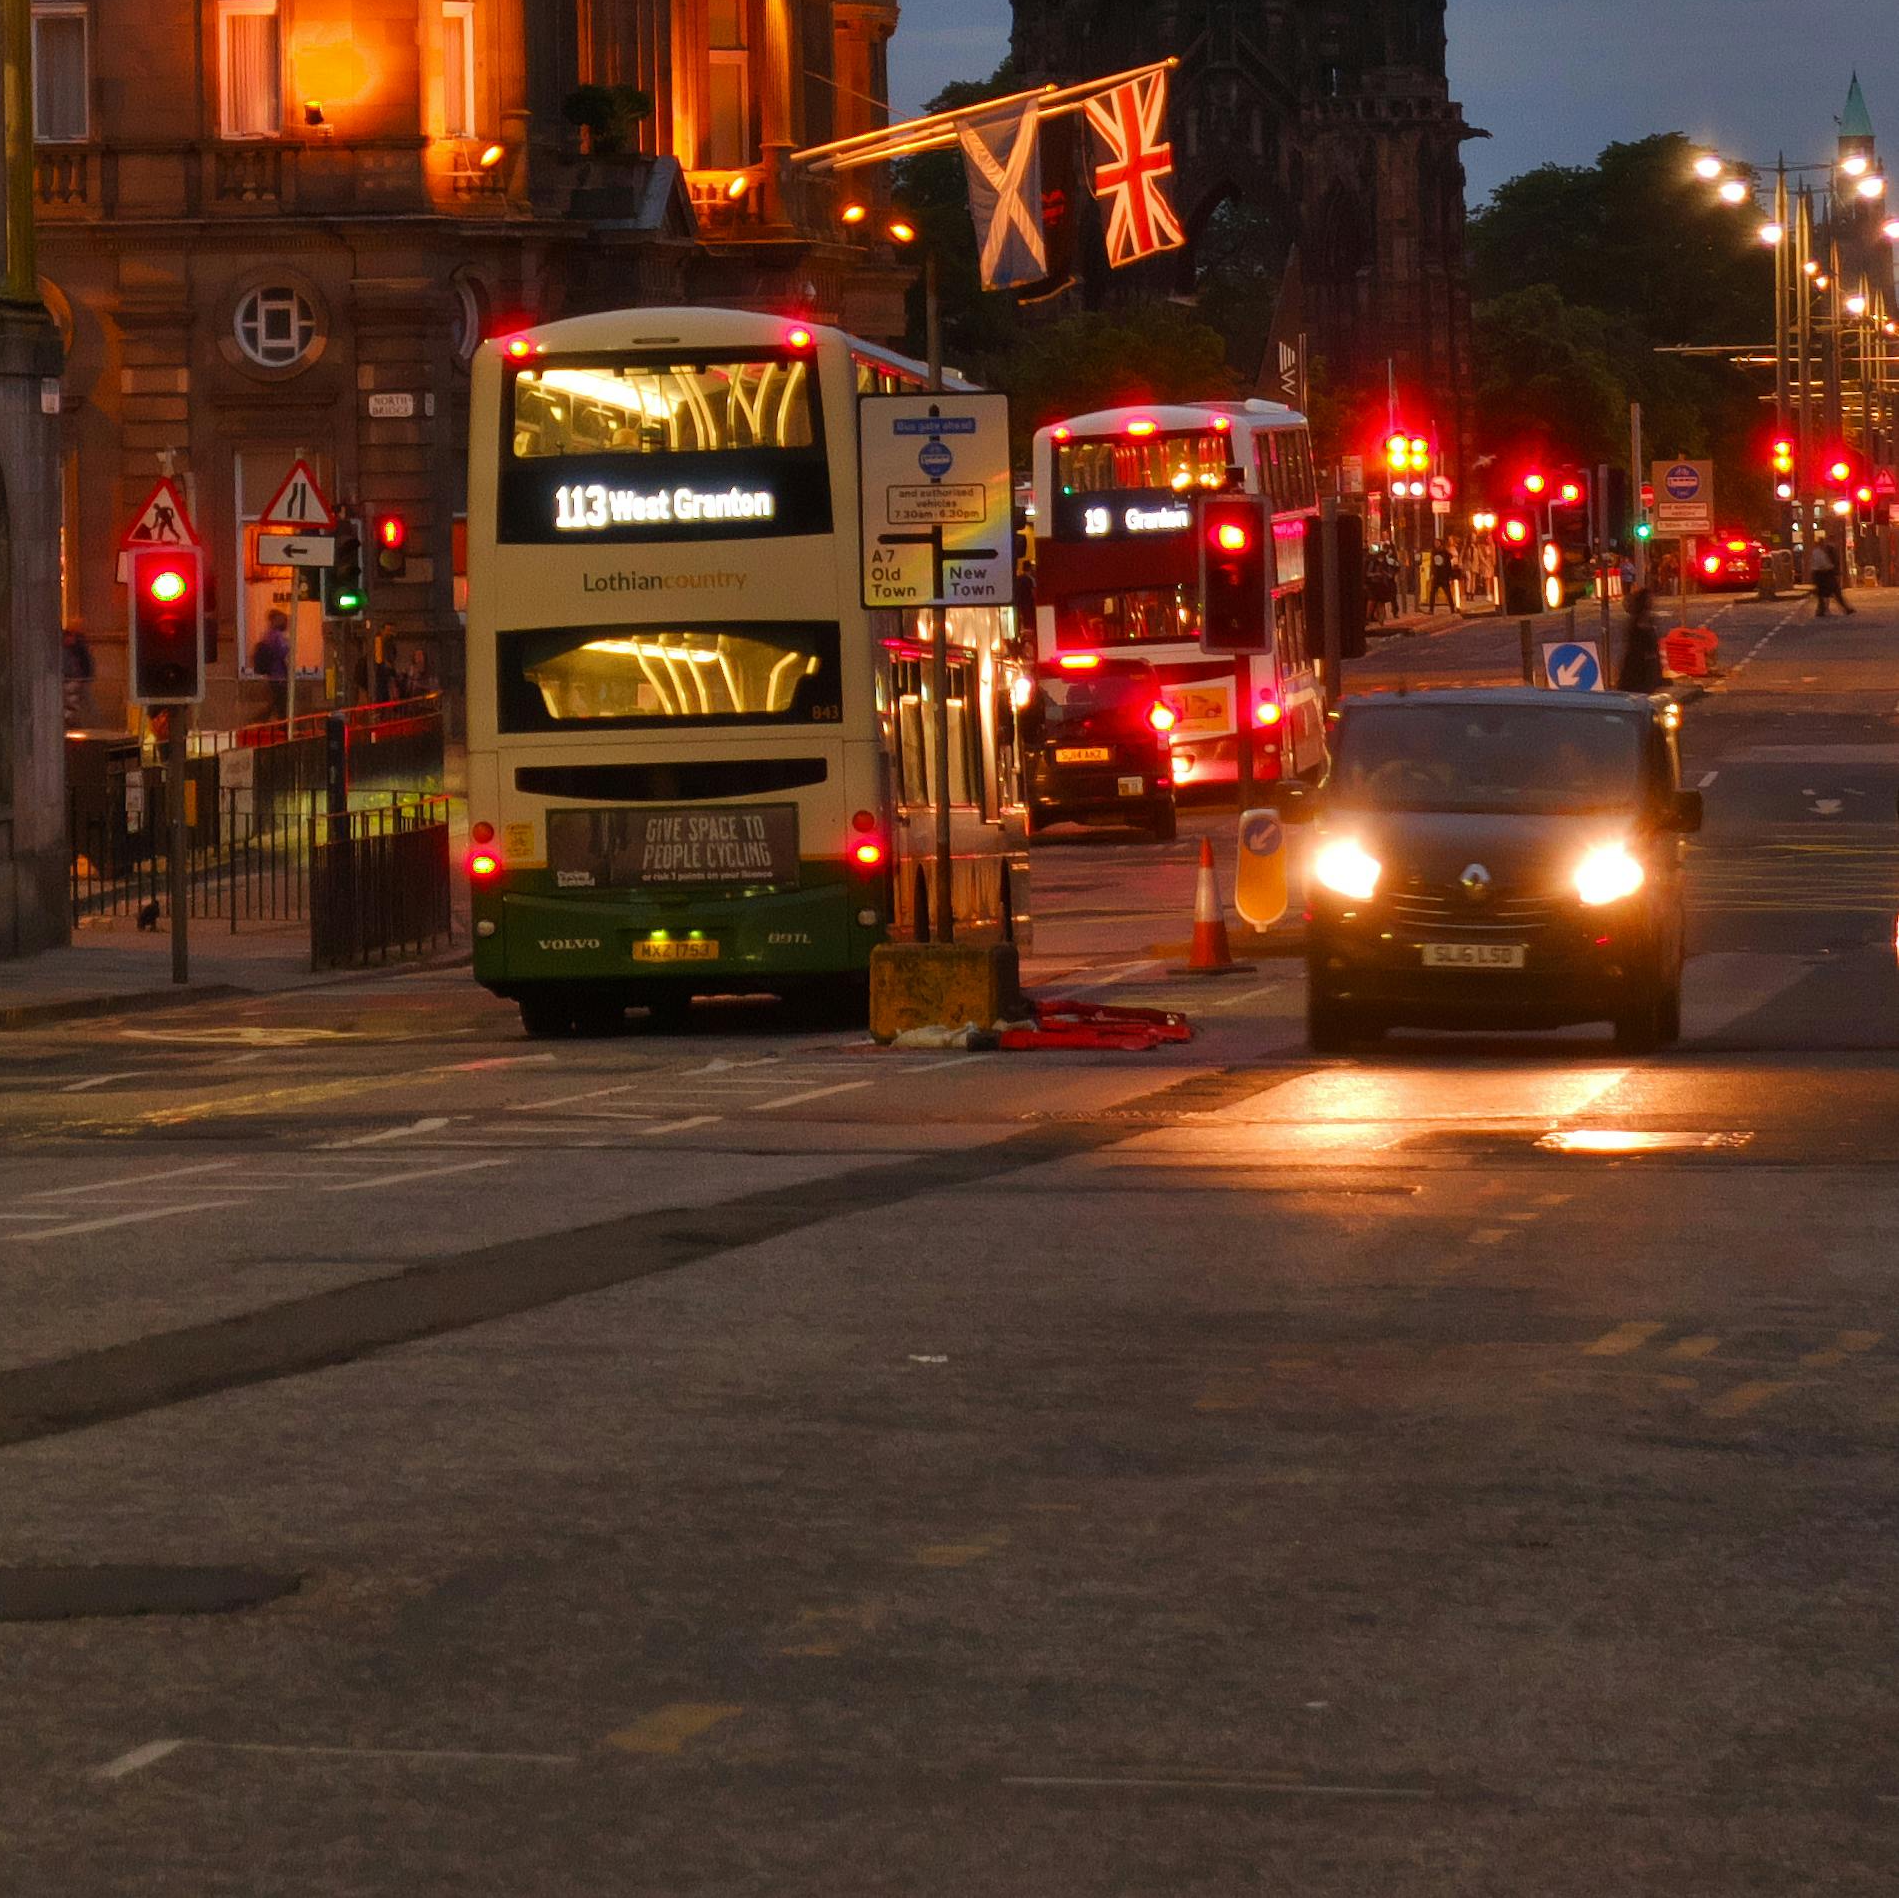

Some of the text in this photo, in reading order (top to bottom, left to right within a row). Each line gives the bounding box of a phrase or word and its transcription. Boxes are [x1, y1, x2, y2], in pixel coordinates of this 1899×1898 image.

[899, 487, 974, 498] and authorised
[555, 485, 773, 528] 113 West Granton
[916, 499, 957, 508] vehicles
[1084, 507, 1109, 534] 19
[871, 567, 901, 581] Old
[949, 566, 987, 579] New
[872, 584, 917, 598] Town
[951, 582, 995, 596] Town
[645, 814, 765, 843] GIVE SPACE TO
[642, 841, 773, 870] PEOPLE CYCLING
[538, 937, 601, 950] VOLVO
